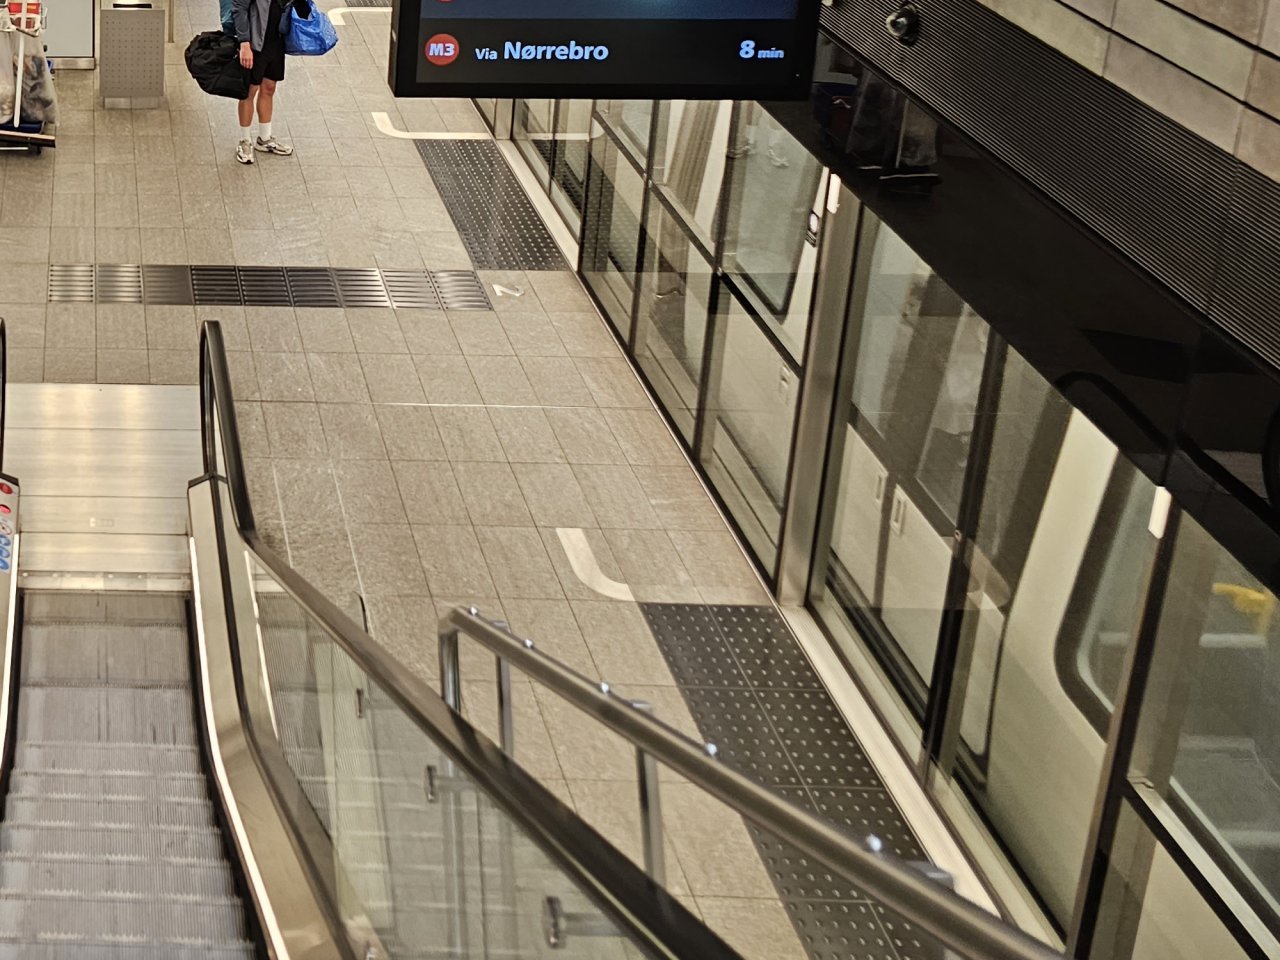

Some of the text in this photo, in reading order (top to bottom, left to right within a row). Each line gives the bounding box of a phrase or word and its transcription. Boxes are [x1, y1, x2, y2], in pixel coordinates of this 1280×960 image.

[428, 42, 456, 57] M3
[475, 40, 609, 61] Via Nørrebro
[739, 39, 785, 59] 8 min
